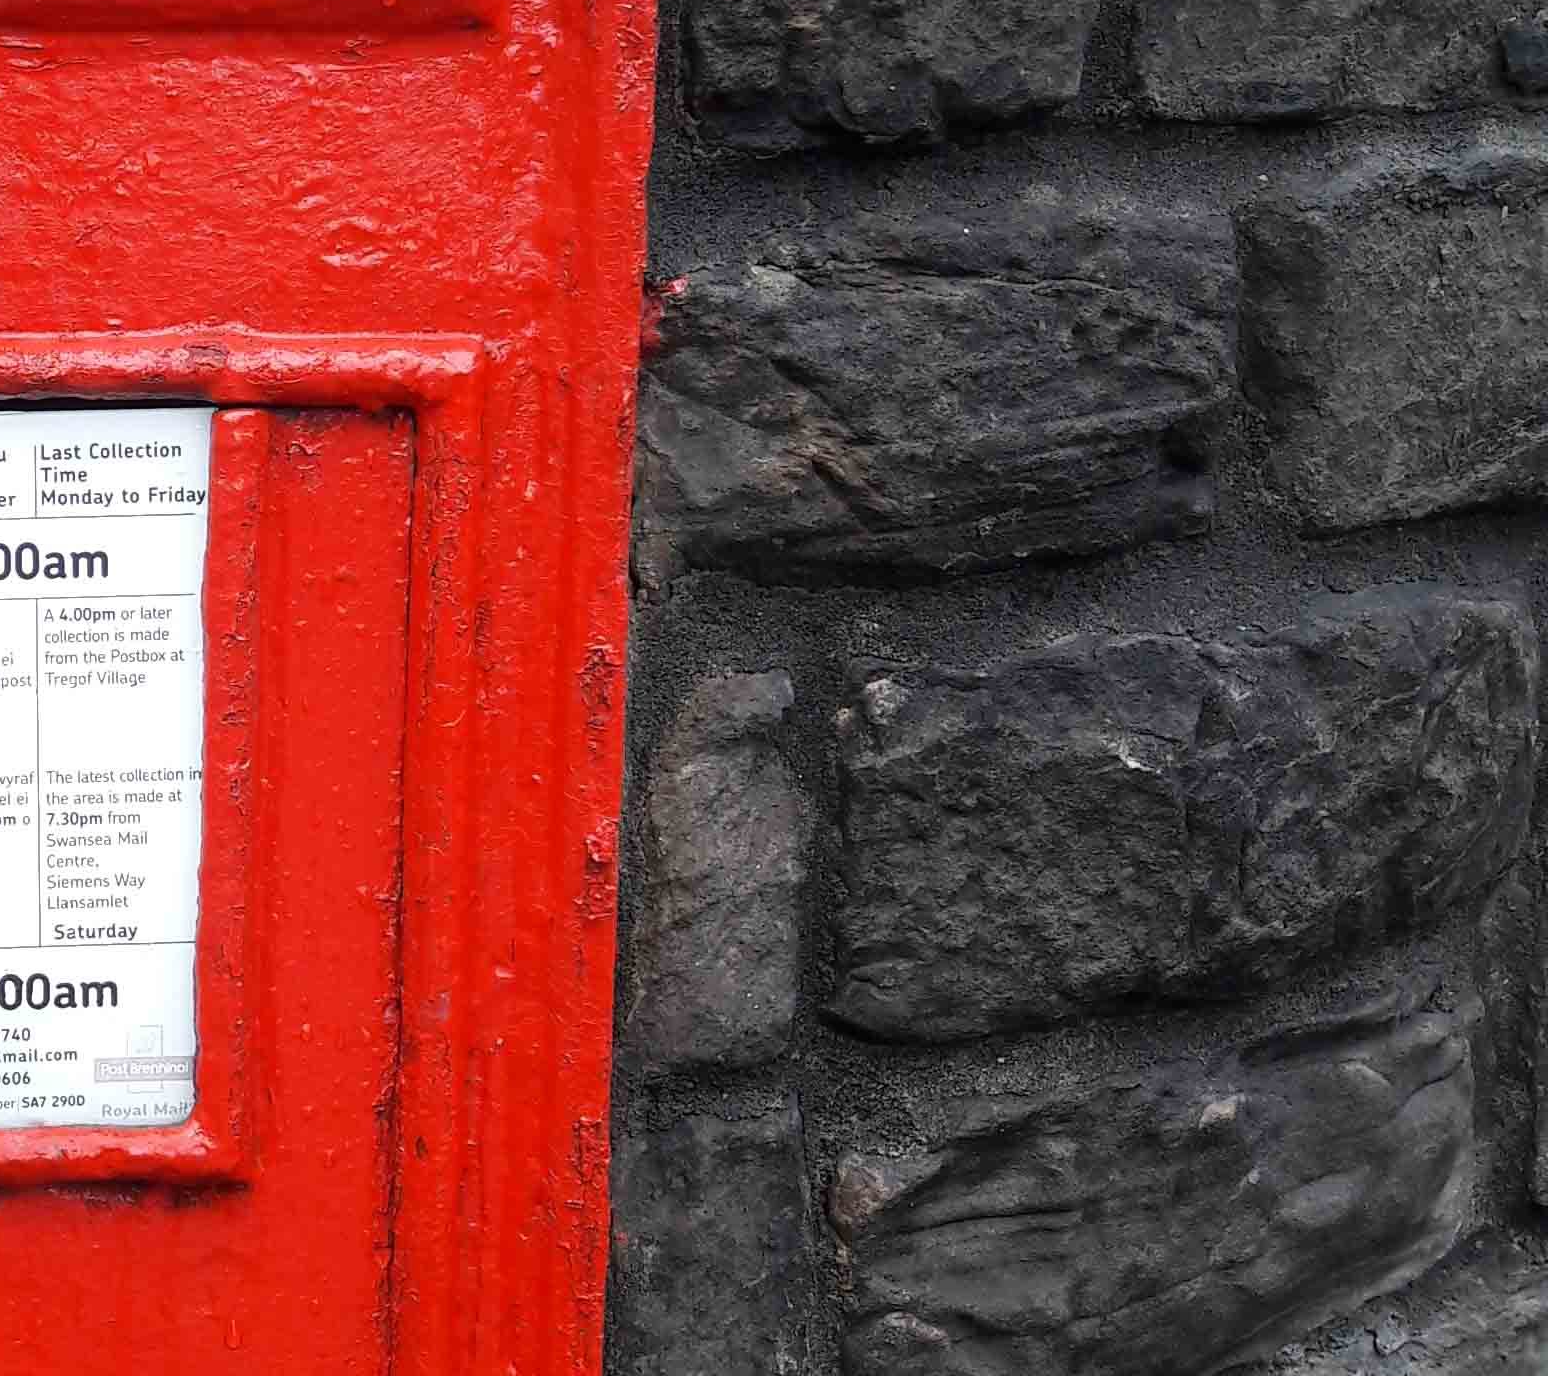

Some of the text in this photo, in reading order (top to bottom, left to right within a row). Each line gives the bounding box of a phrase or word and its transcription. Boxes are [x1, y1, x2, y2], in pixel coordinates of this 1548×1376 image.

[40, 441, 183, 462] Last Collection
[40, 466, 89, 483] Time
[40, 485, 206, 507] Monday to Friday
[44, 606, 173, 624] A 4.00pm or later
[44, 627, 170, 644] collection is made
[1, 651, 14, 666] ei
[44, 649, 185, 665] from the Postbox at
[44, 670, 147, 688] Tregof Village
[46, 771, 73, 784] The
[77, 769, 116, 783] latest
[119, 768, 184, 782] collection
[16, 792, 29, 805] ei
[46, 789, 183, 805] the area is made at
[22, 814, 31, 825] o
[46, 810, 141, 827] 7.30pm from
[46, 831, 148, 848] Swansea Mail
[46, 873, 146, 889] Siemens Way
[47, 895, 129, 910] Llansamlet
[54, 924, 138, 941] Saturday
[21, 1096, 46, 1109] SA7
[101, 1103, 148, 1119] Royal
